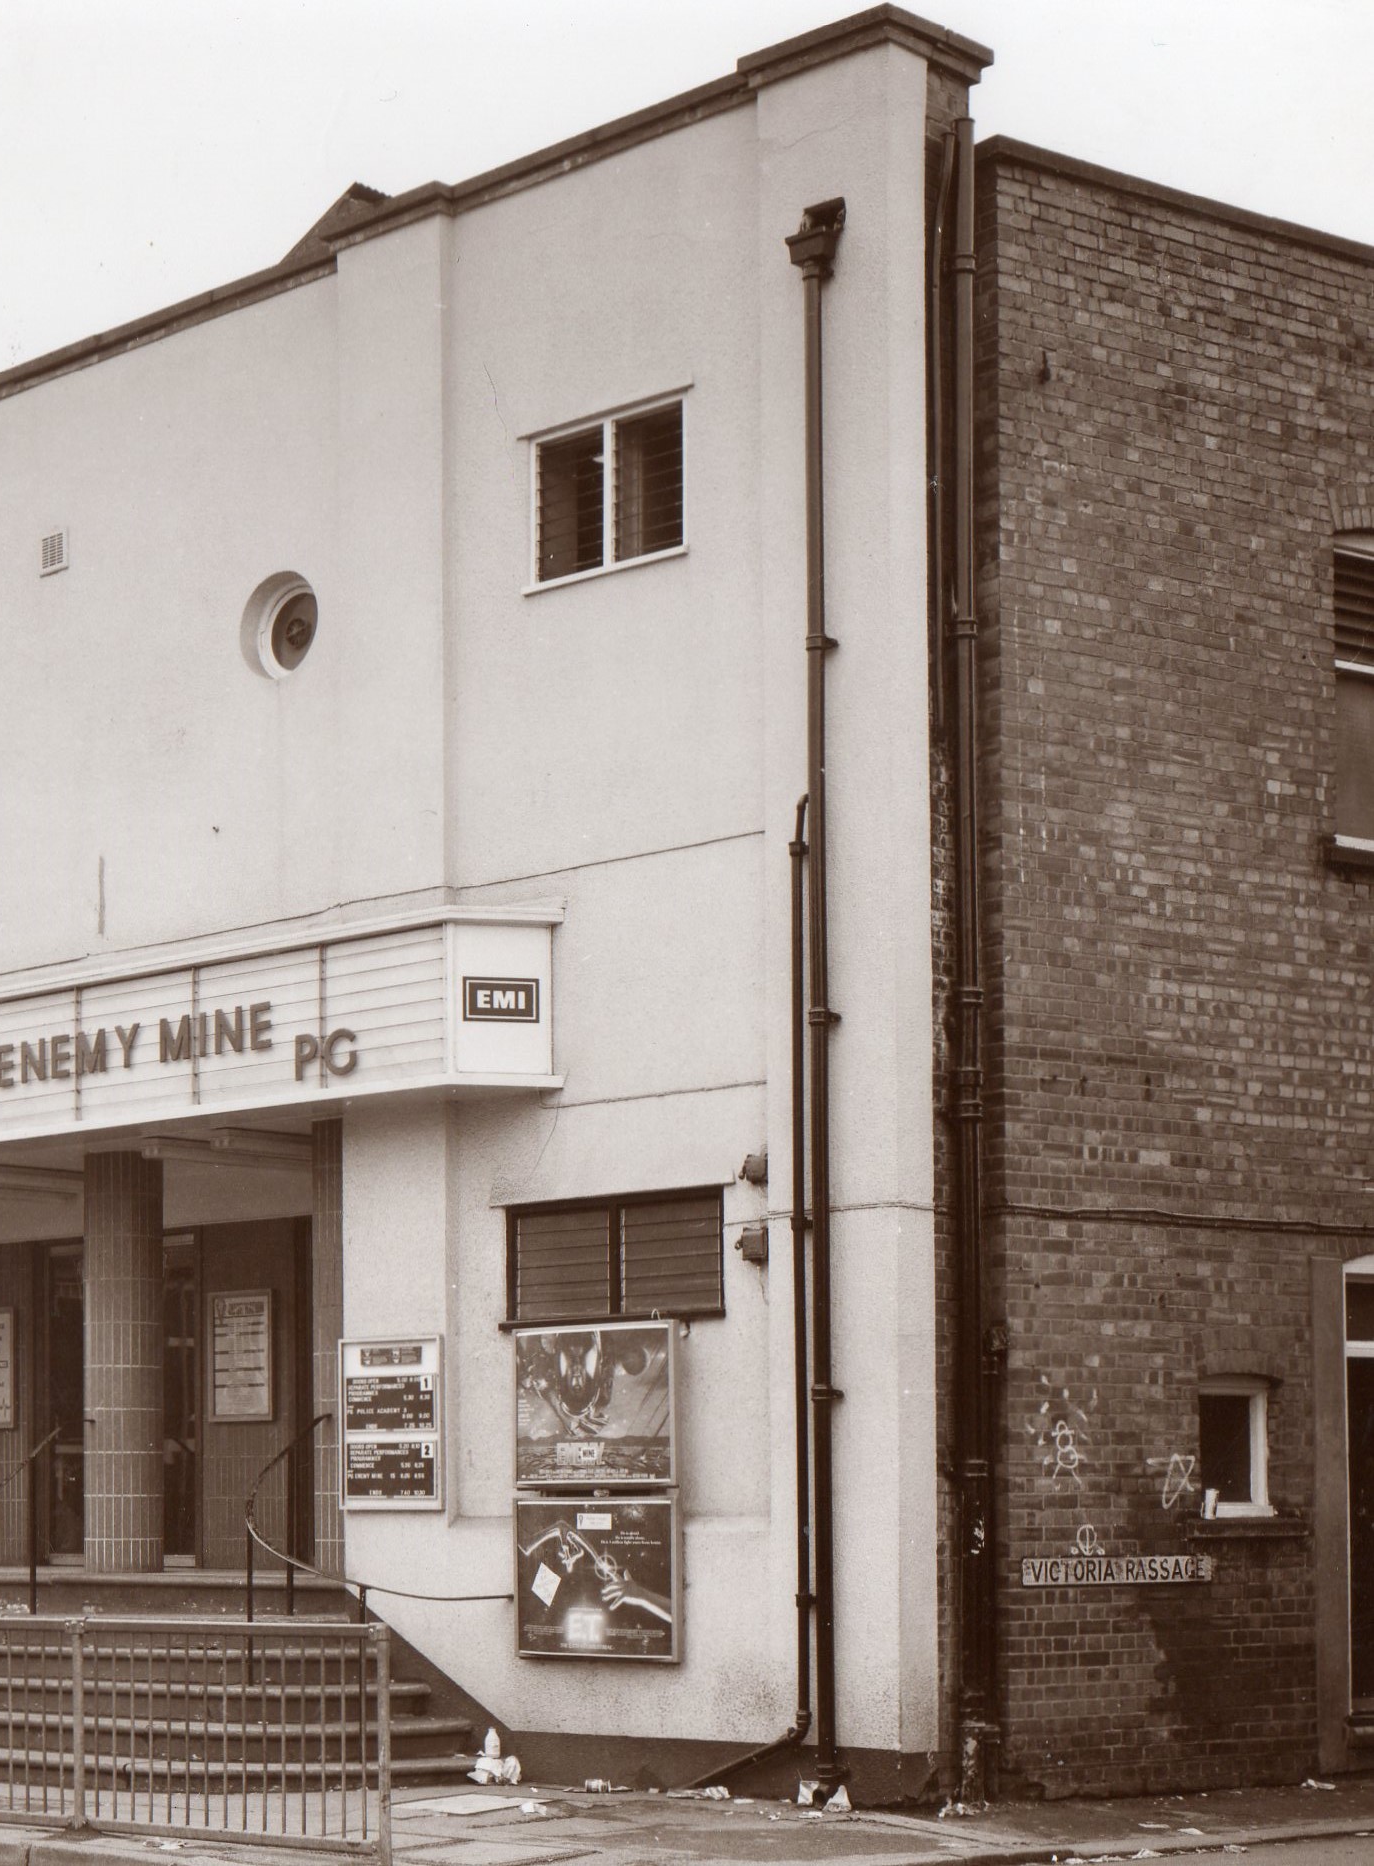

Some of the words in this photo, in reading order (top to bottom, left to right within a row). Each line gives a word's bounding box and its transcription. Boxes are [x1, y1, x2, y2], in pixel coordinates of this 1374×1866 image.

[476, 989, 526, 1010] EMI
[159, 1001, 272, 1063] MINE
[294, 1028, 357, 1081] PG
[424, 1377, 428, 1389] 1
[424, 1444, 430, 1456] 2
[1031, 1559, 1115, 1583] VICTORIA
